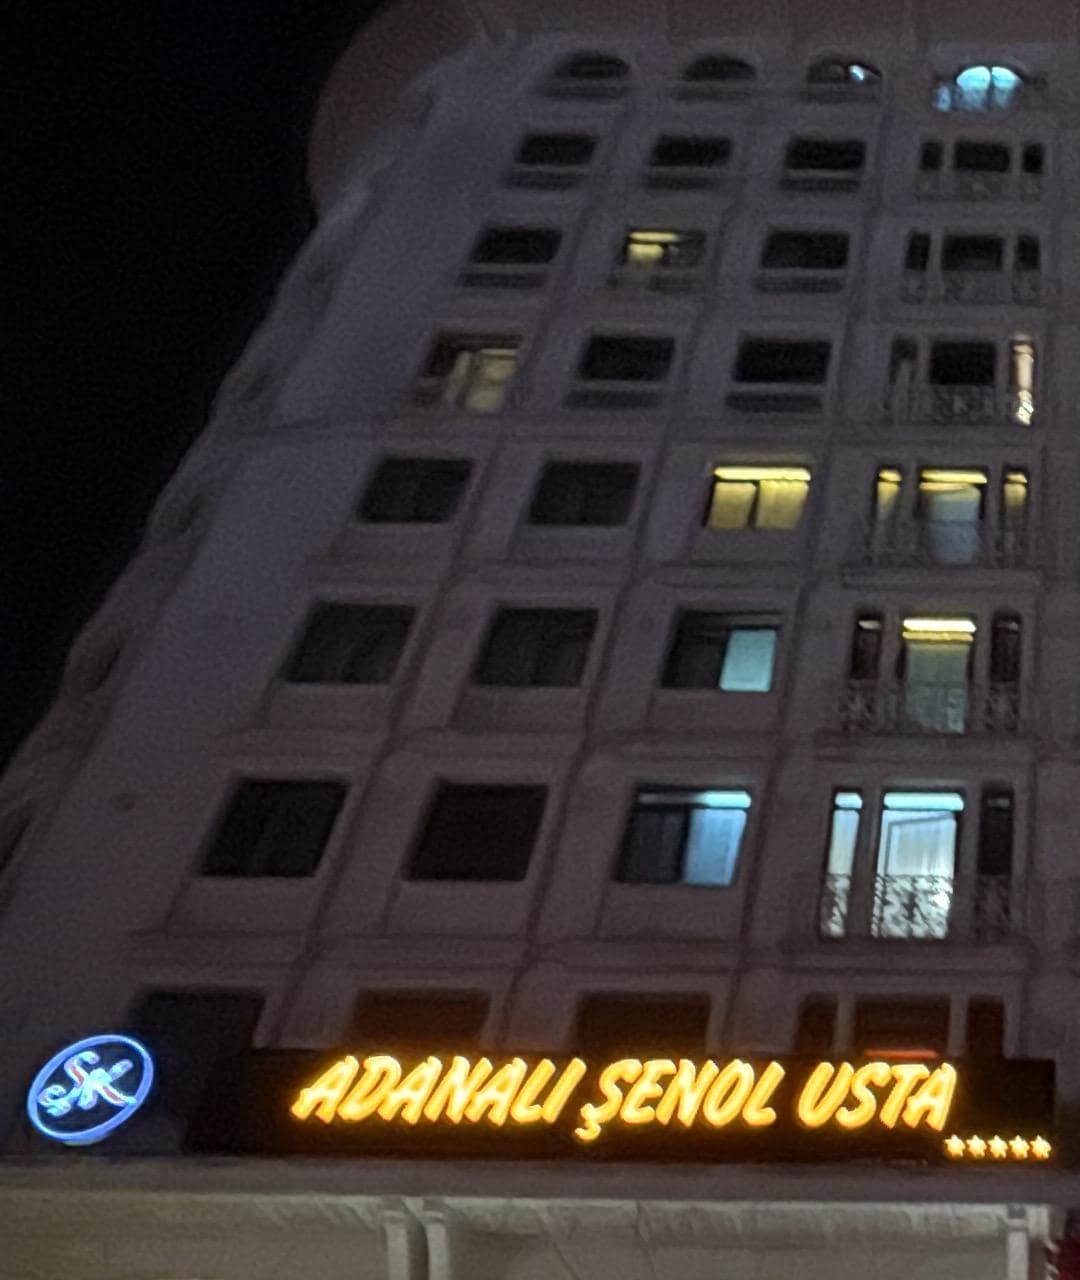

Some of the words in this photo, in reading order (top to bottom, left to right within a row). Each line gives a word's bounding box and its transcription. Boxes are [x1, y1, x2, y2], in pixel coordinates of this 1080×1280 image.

[290, 1054, 588, 1128] ADANALI
[573, 1057, 787, 1143] ŞENOL
[795, 1056, 959, 1133] USTA
